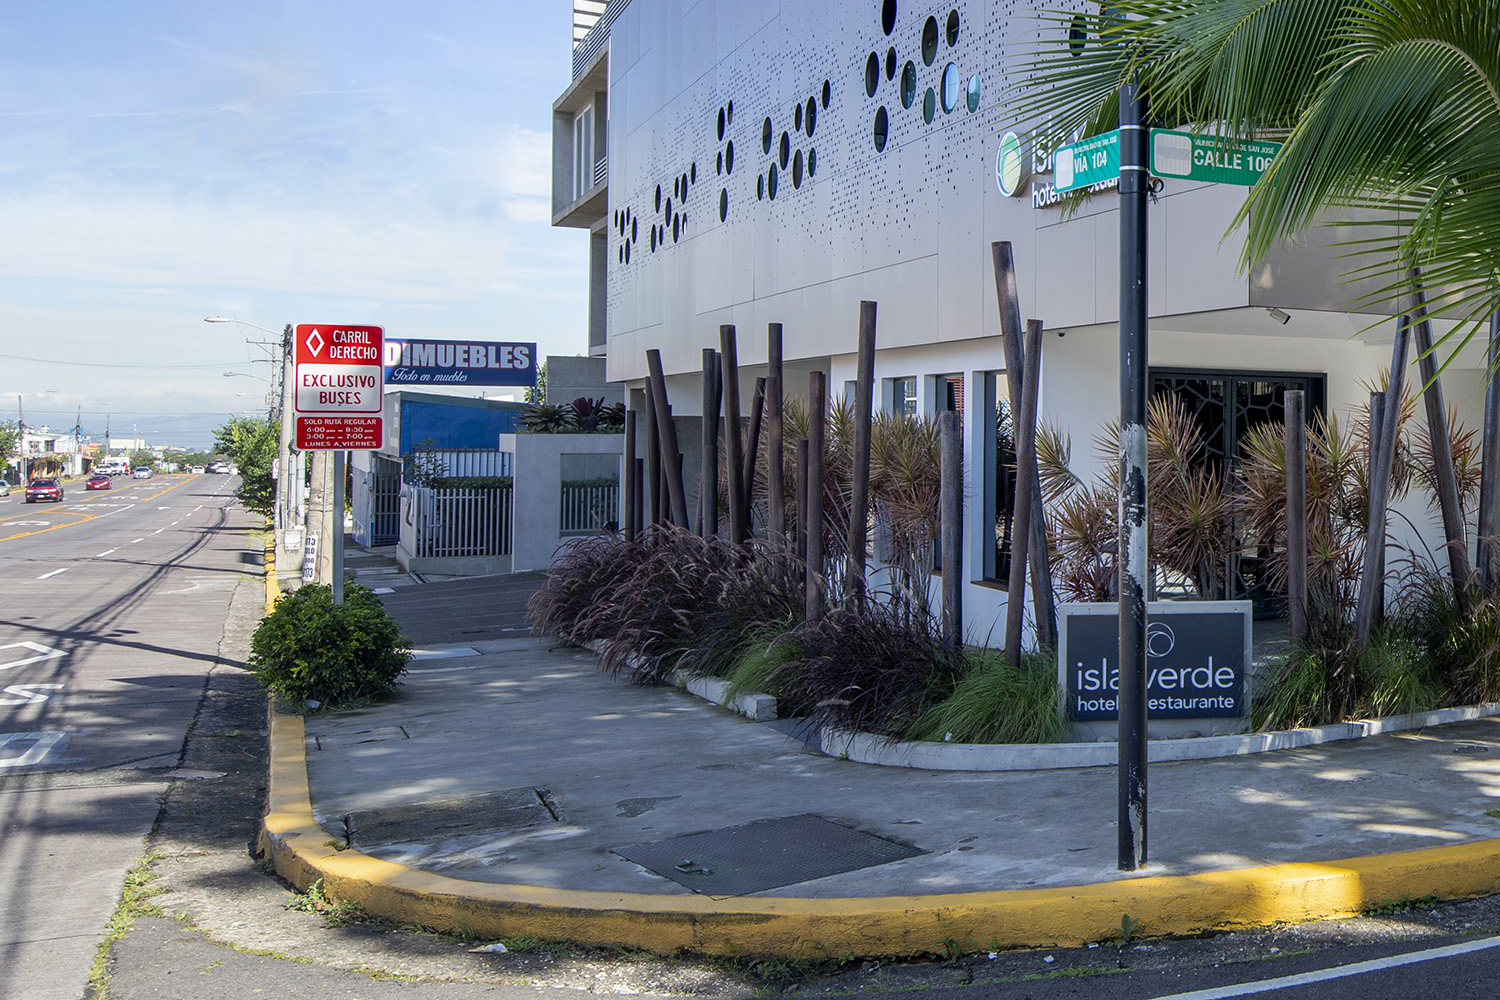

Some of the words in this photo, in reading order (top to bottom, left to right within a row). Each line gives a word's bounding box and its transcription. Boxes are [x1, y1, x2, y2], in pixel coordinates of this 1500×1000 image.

[1074, 153, 1088, 174] VÍA
[1092, 150, 1107, 169] 104
[1194, 149, 1242, 170] CALLE
[333, 330, 371, 344] CARRIL
[330, 346, 378, 360] DERECHO
[303, 374, 376, 388] EXCLUSIVO
[391, 367, 418, 381] Todo
[420, 373, 431, 381] en
[433, 370, 468, 382] muebles
[319, 391, 361, 405] BUSES
[1077, 696, 1119, 712] hotel
[1147, 696, 1234, 710] estaurante
